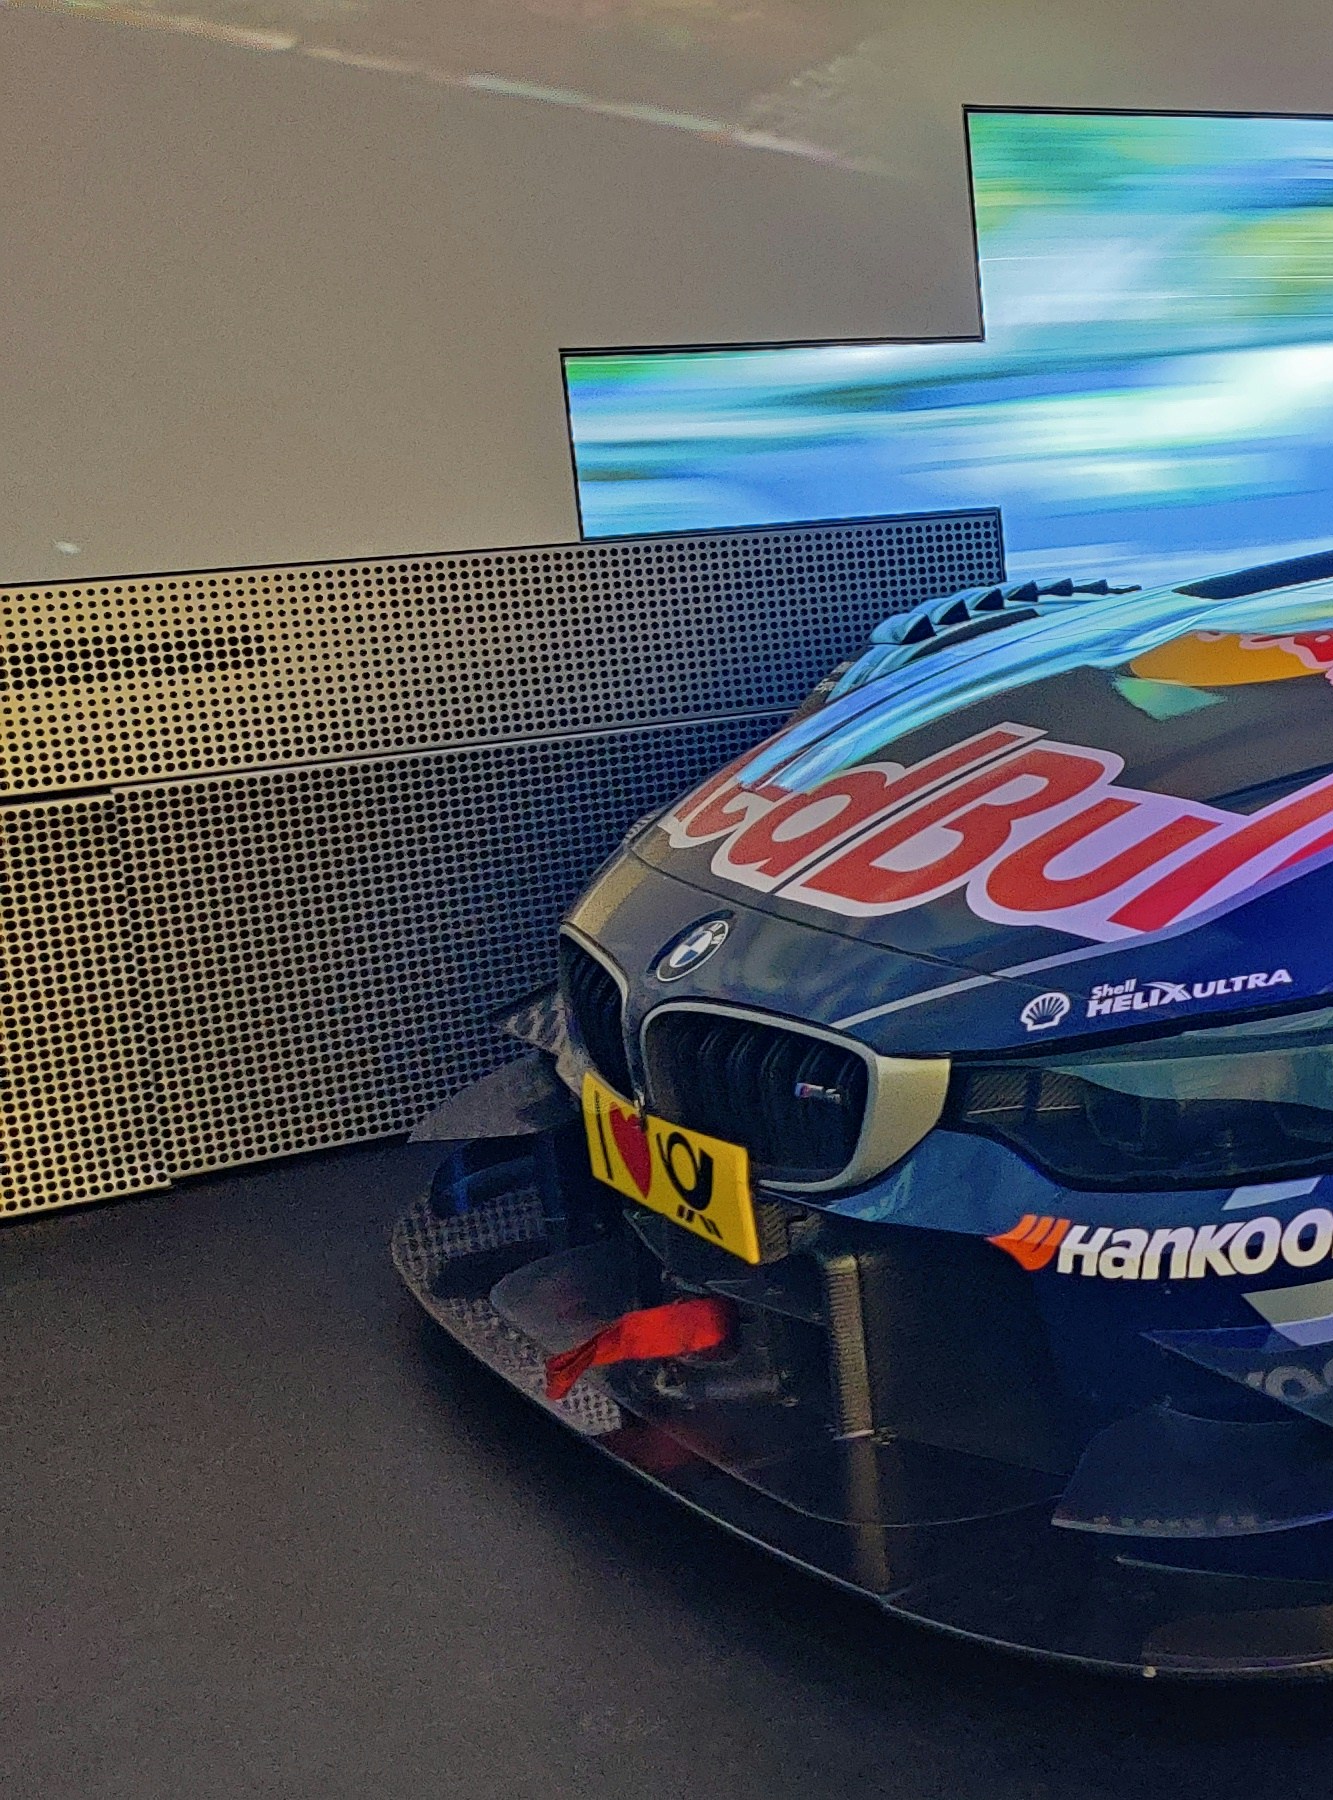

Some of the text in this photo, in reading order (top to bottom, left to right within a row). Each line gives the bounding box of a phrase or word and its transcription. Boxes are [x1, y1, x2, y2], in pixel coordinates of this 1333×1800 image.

[1086, 969, 1292, 1018] HELIX ULTRA
[1091, 978, 1137, 1000] Shell
